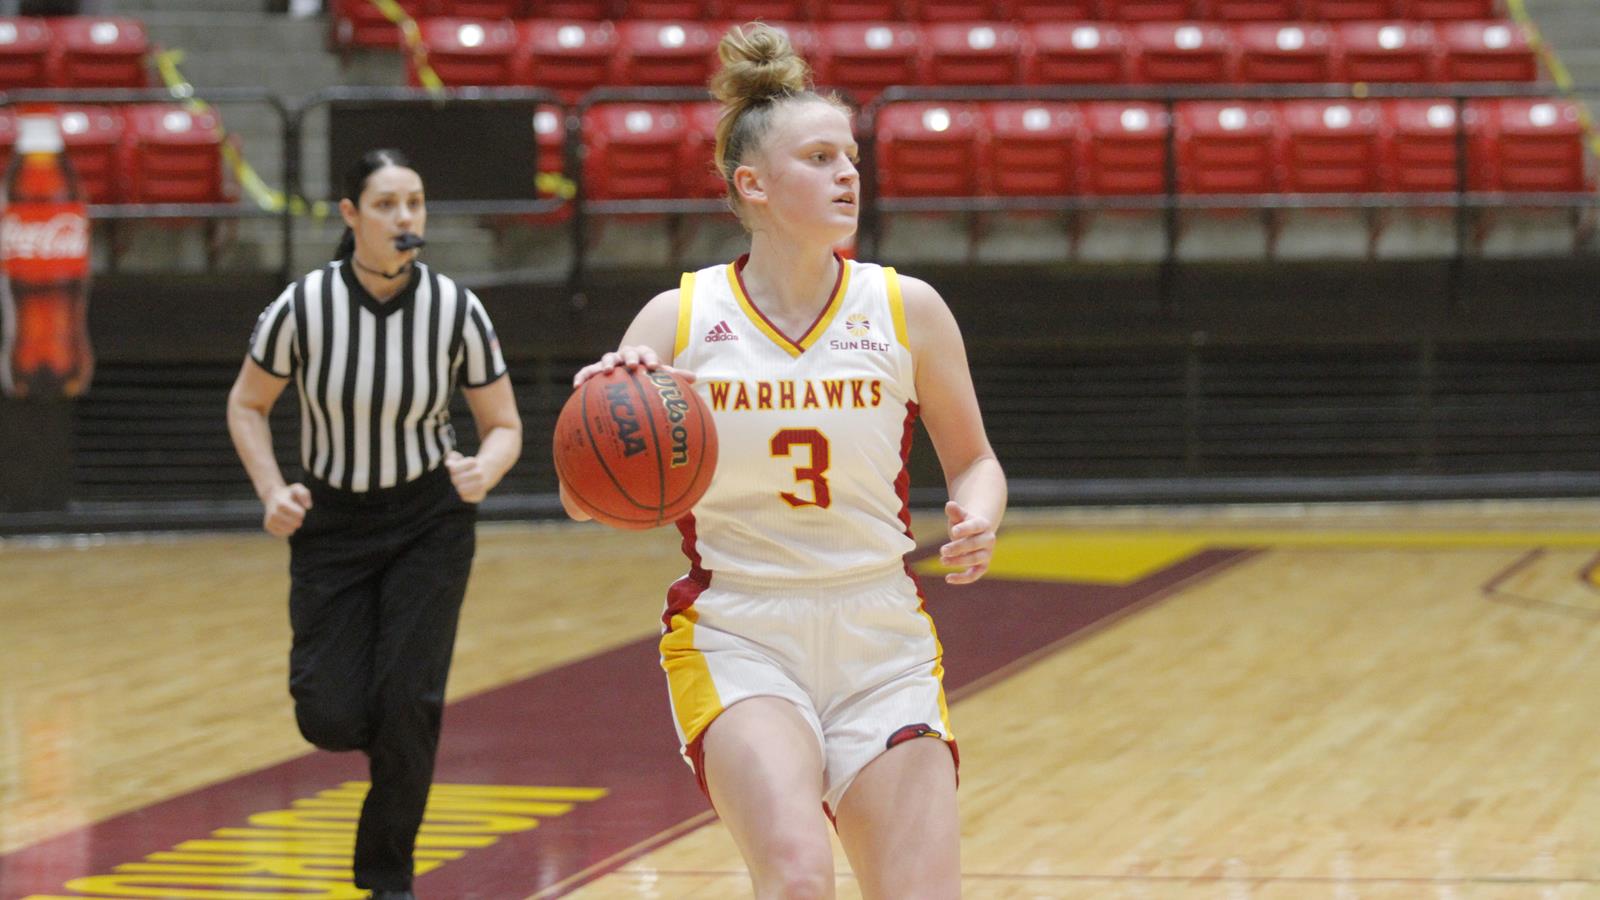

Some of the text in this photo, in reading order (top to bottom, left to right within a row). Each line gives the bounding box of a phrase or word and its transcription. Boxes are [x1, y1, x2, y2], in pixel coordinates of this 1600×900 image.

[705, 332, 738, 342] adidas
[604, 382, 648, 457] NCAA
[708, 379, 882, 412] WARHAWKS
[768, 427, 831, 509] 3
[20, 780, 609, 900] MONRO
